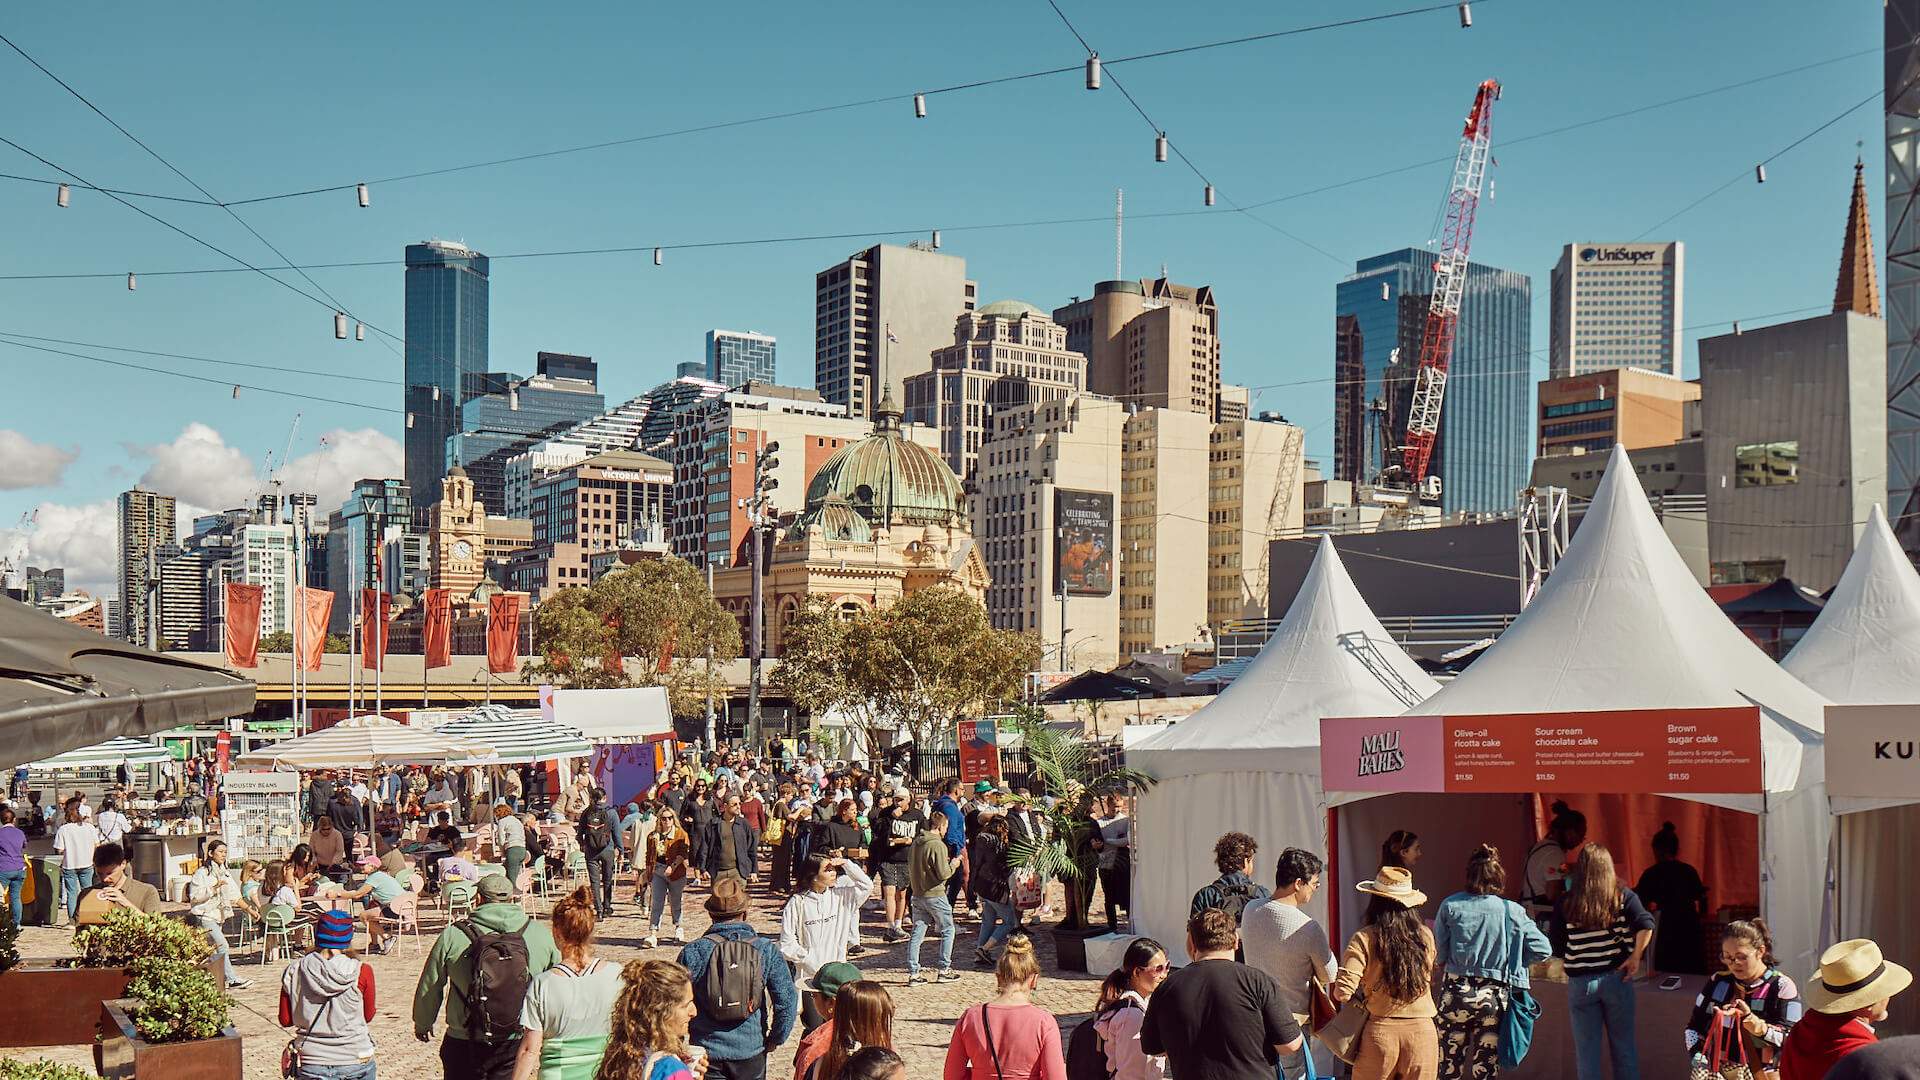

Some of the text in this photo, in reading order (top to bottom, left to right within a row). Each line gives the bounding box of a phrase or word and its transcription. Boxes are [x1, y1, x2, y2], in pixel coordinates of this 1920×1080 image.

[1597, 247, 1655, 265] UniSuper
[601, 469, 640, 481] VICTORIA
[961, 727, 993, 736] FESTIVAL
[1535, 727, 1583, 736] Sour cream
[1667, 723, 1697, 733] Brown
[961, 734, 976, 742] BAR
[1535, 737, 1599, 746] chocolate cake
[1667, 734, 1719, 746] sugar cake
[1362, 730, 1400, 757] MALI
[1454, 739, 1501, 748] ricotta cake
[1875, 741, 1920, 759] KU
[1358, 750, 1405, 777] BAKES
[1455, 773, 1473, 781] $11.50
[1535, 773, 1555, 781] $11.50
[1668, 772, 1690, 781] $11.50
